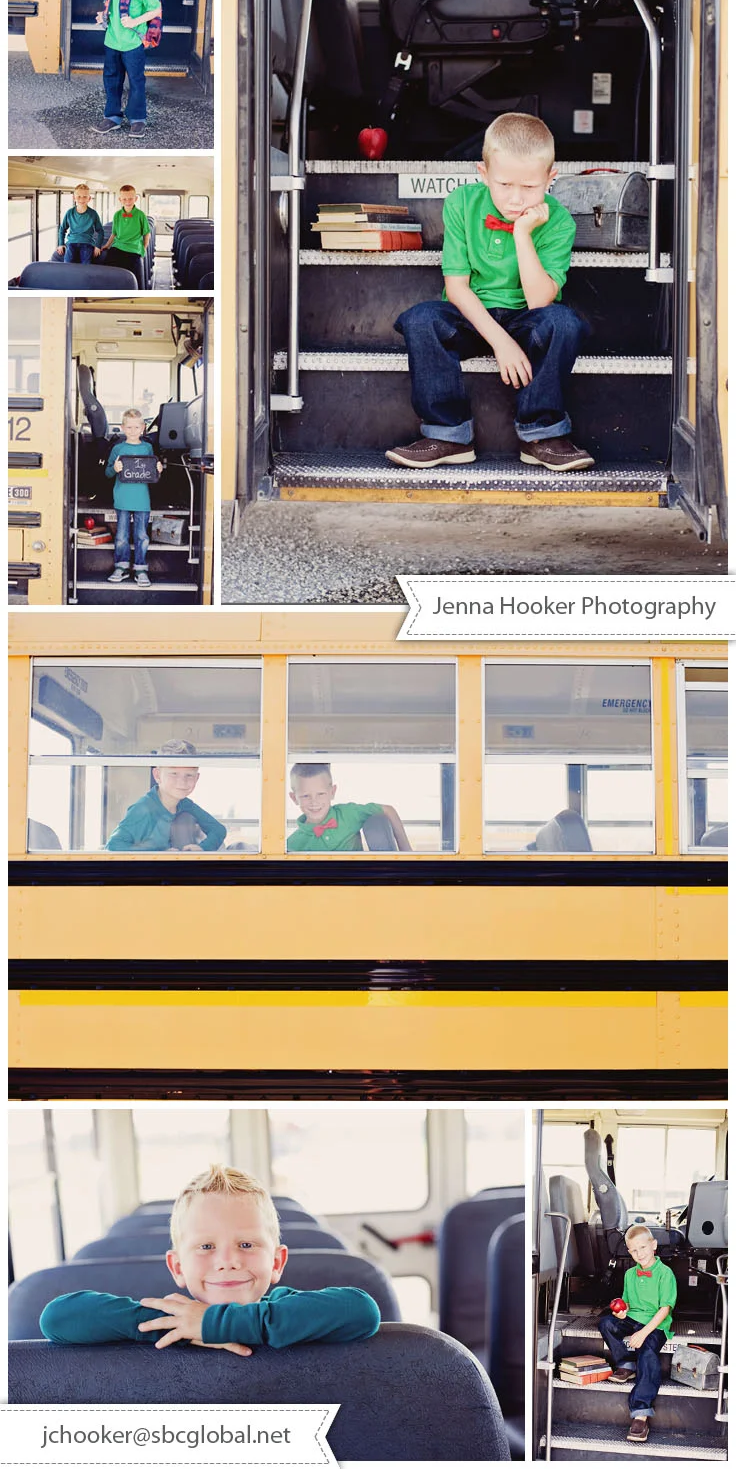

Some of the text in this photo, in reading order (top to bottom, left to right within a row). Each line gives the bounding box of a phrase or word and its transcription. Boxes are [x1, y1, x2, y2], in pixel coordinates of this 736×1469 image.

[8, 416, 31, 441] 12
[123, 468, 151, 479] Grade
[14, 488, 29, 497] 300
